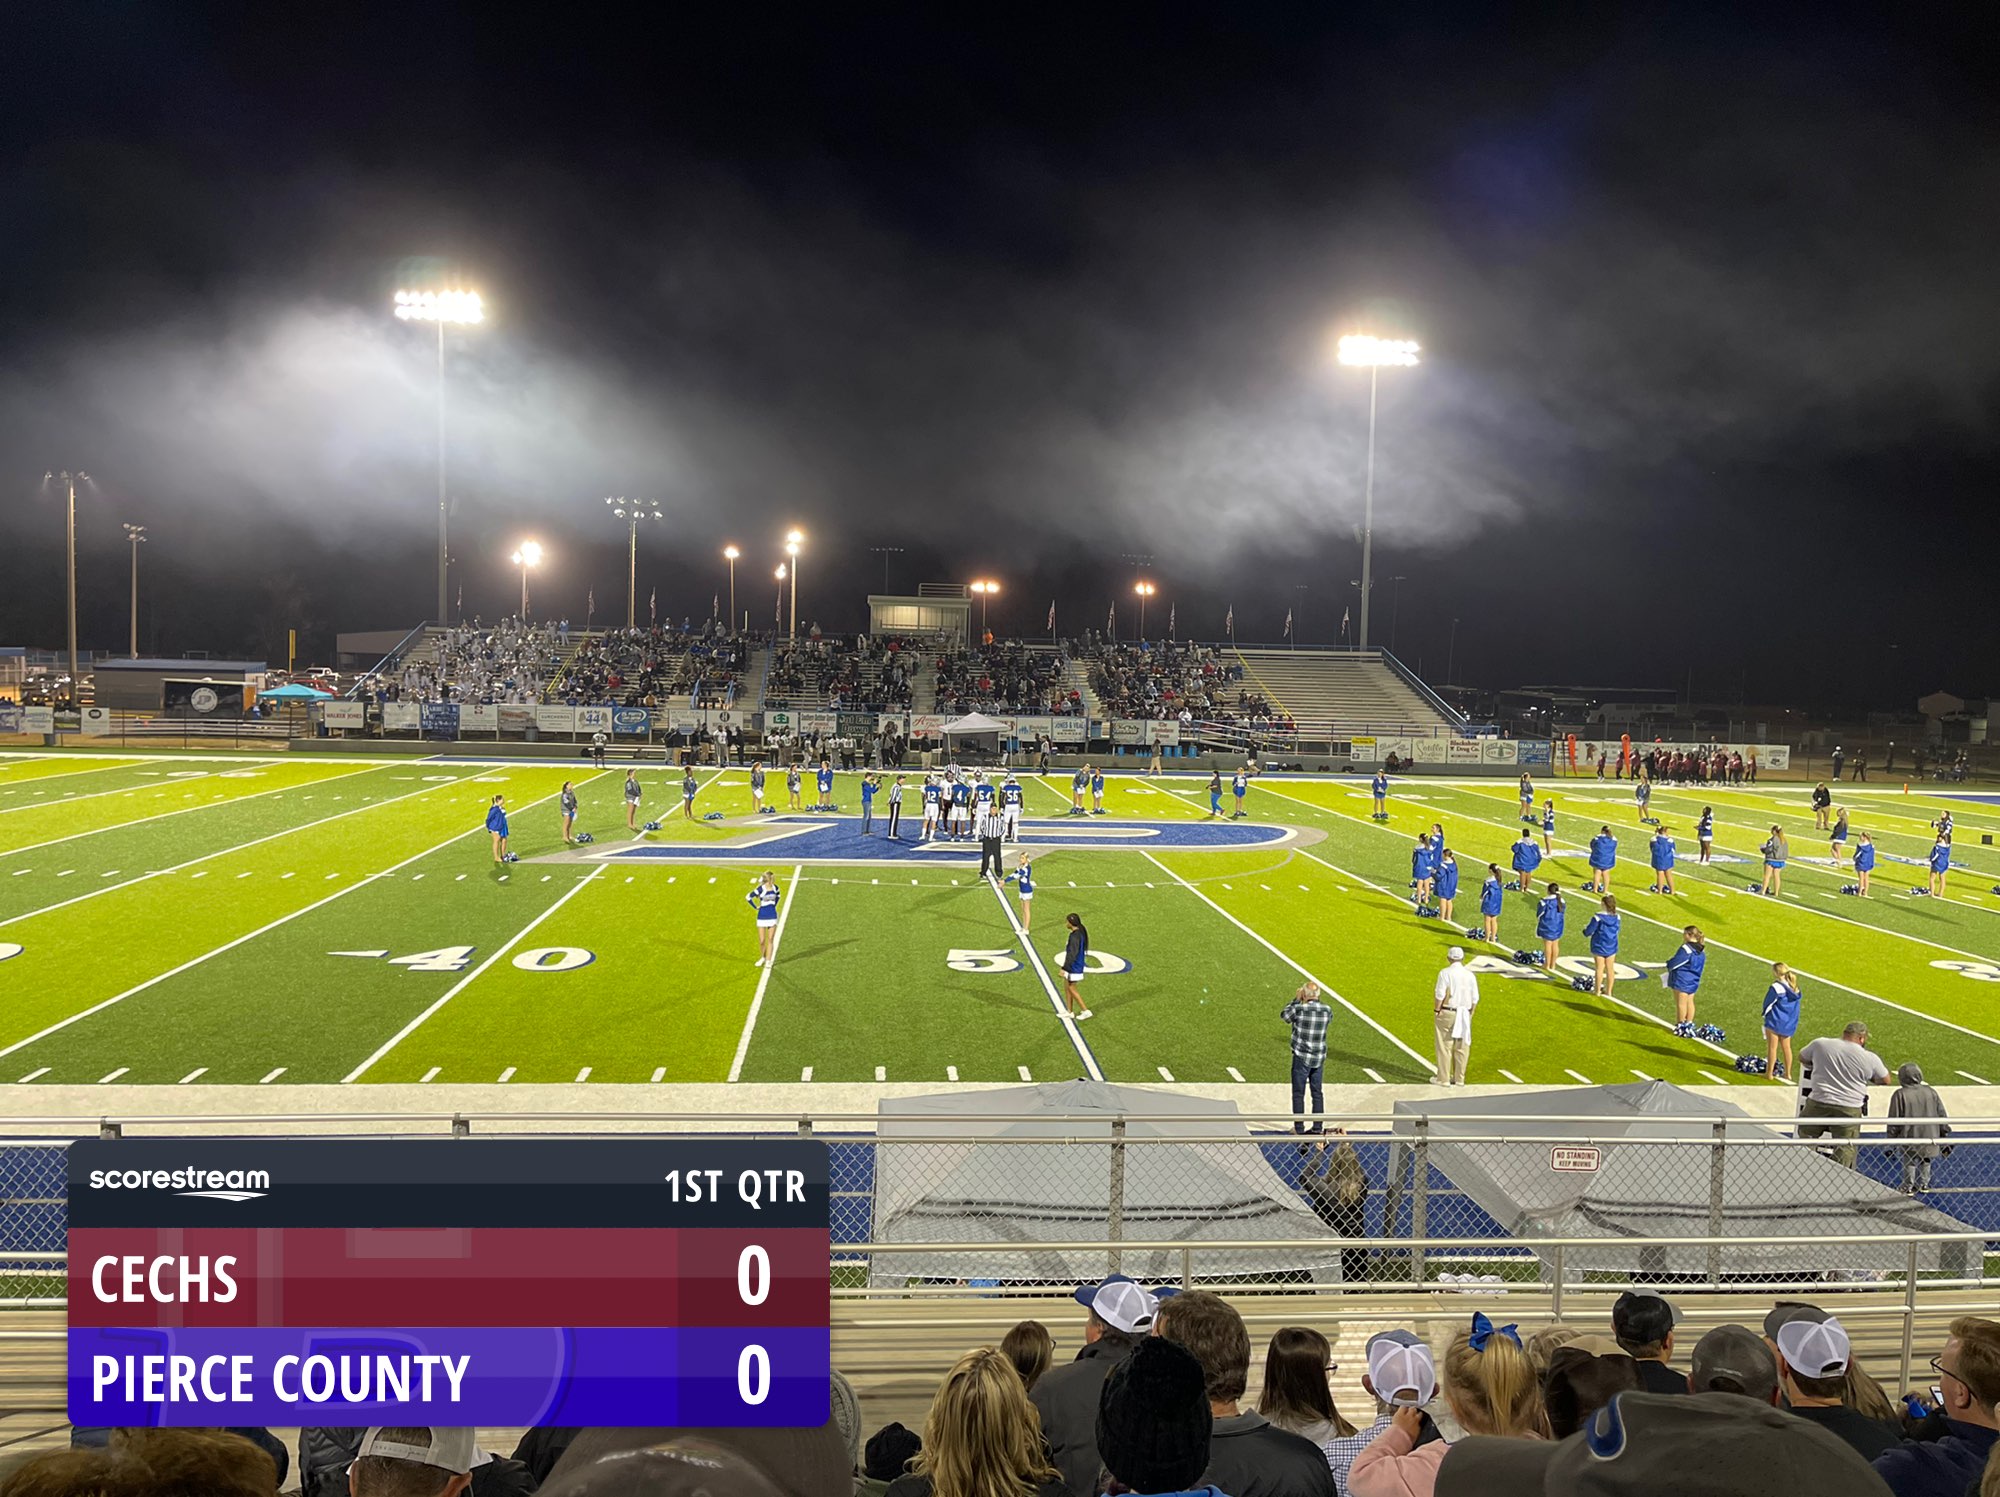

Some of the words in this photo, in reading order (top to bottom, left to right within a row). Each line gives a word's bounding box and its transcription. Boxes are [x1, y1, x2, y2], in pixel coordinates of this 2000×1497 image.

[585, 714, 601, 725] 44
[927, 791, 936, 802] 12
[957, 790, 963, 801] 4
[1006, 790, 1020, 802] 56
[1556, 1151, 1565, 1159] NO
[1566, 1151, 1596, 1160] STANDING
